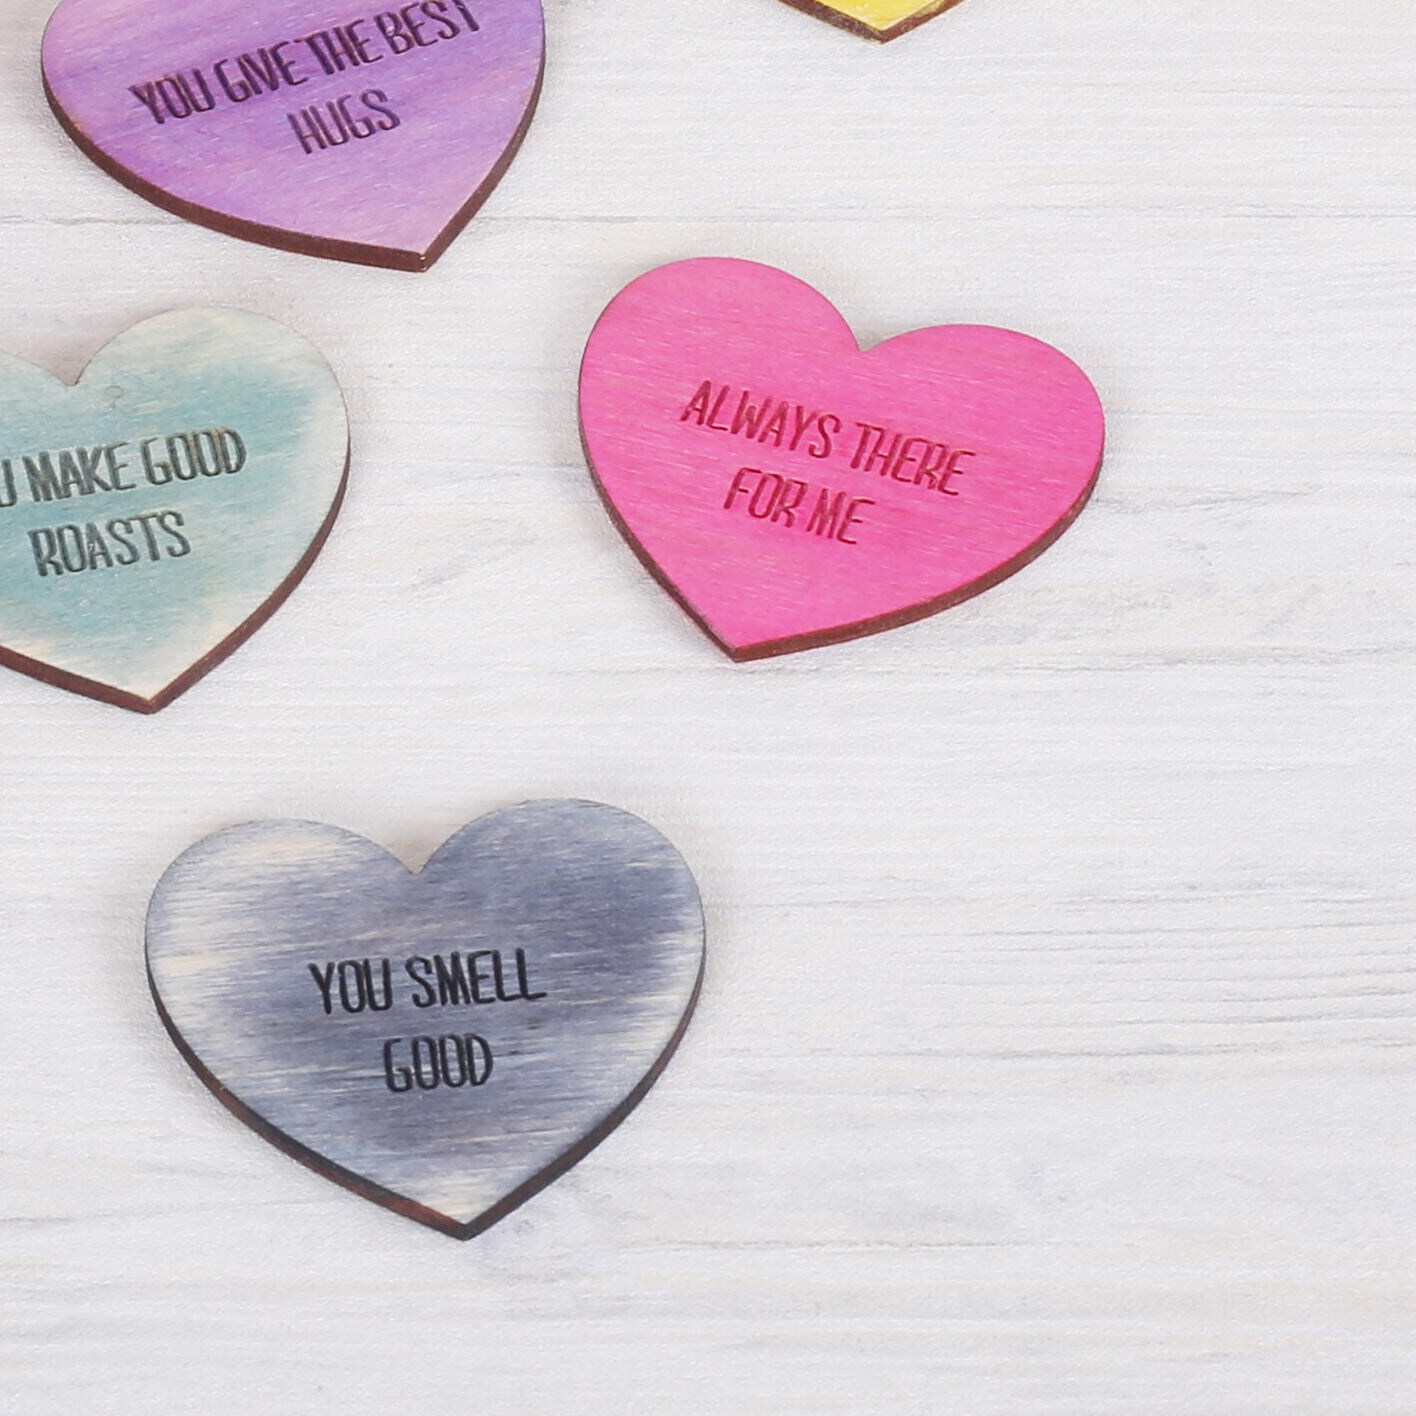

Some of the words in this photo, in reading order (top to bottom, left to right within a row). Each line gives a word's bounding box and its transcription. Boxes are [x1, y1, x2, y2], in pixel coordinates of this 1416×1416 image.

[128, 67, 216, 124] YOU
[213, 40, 308, 103] GIVE
[294, 18, 384, 75] THE
[287, 88, 401, 154] HUGS
[22, 440, 136, 502] MAKE
[140, 427, 247, 485] GOOD
[680, 380, 843, 459] ALWAYS
[850, 422, 976, 496] THERE
[723, 467, 808, 528] FOR
[806, 488, 876, 545] ME
[28, 510, 191, 577] ROASTS
[308, 958, 393, 1014] YOU
[404, 947, 547, 1008] SMELL
[384, 1033, 494, 1093] GOOD
